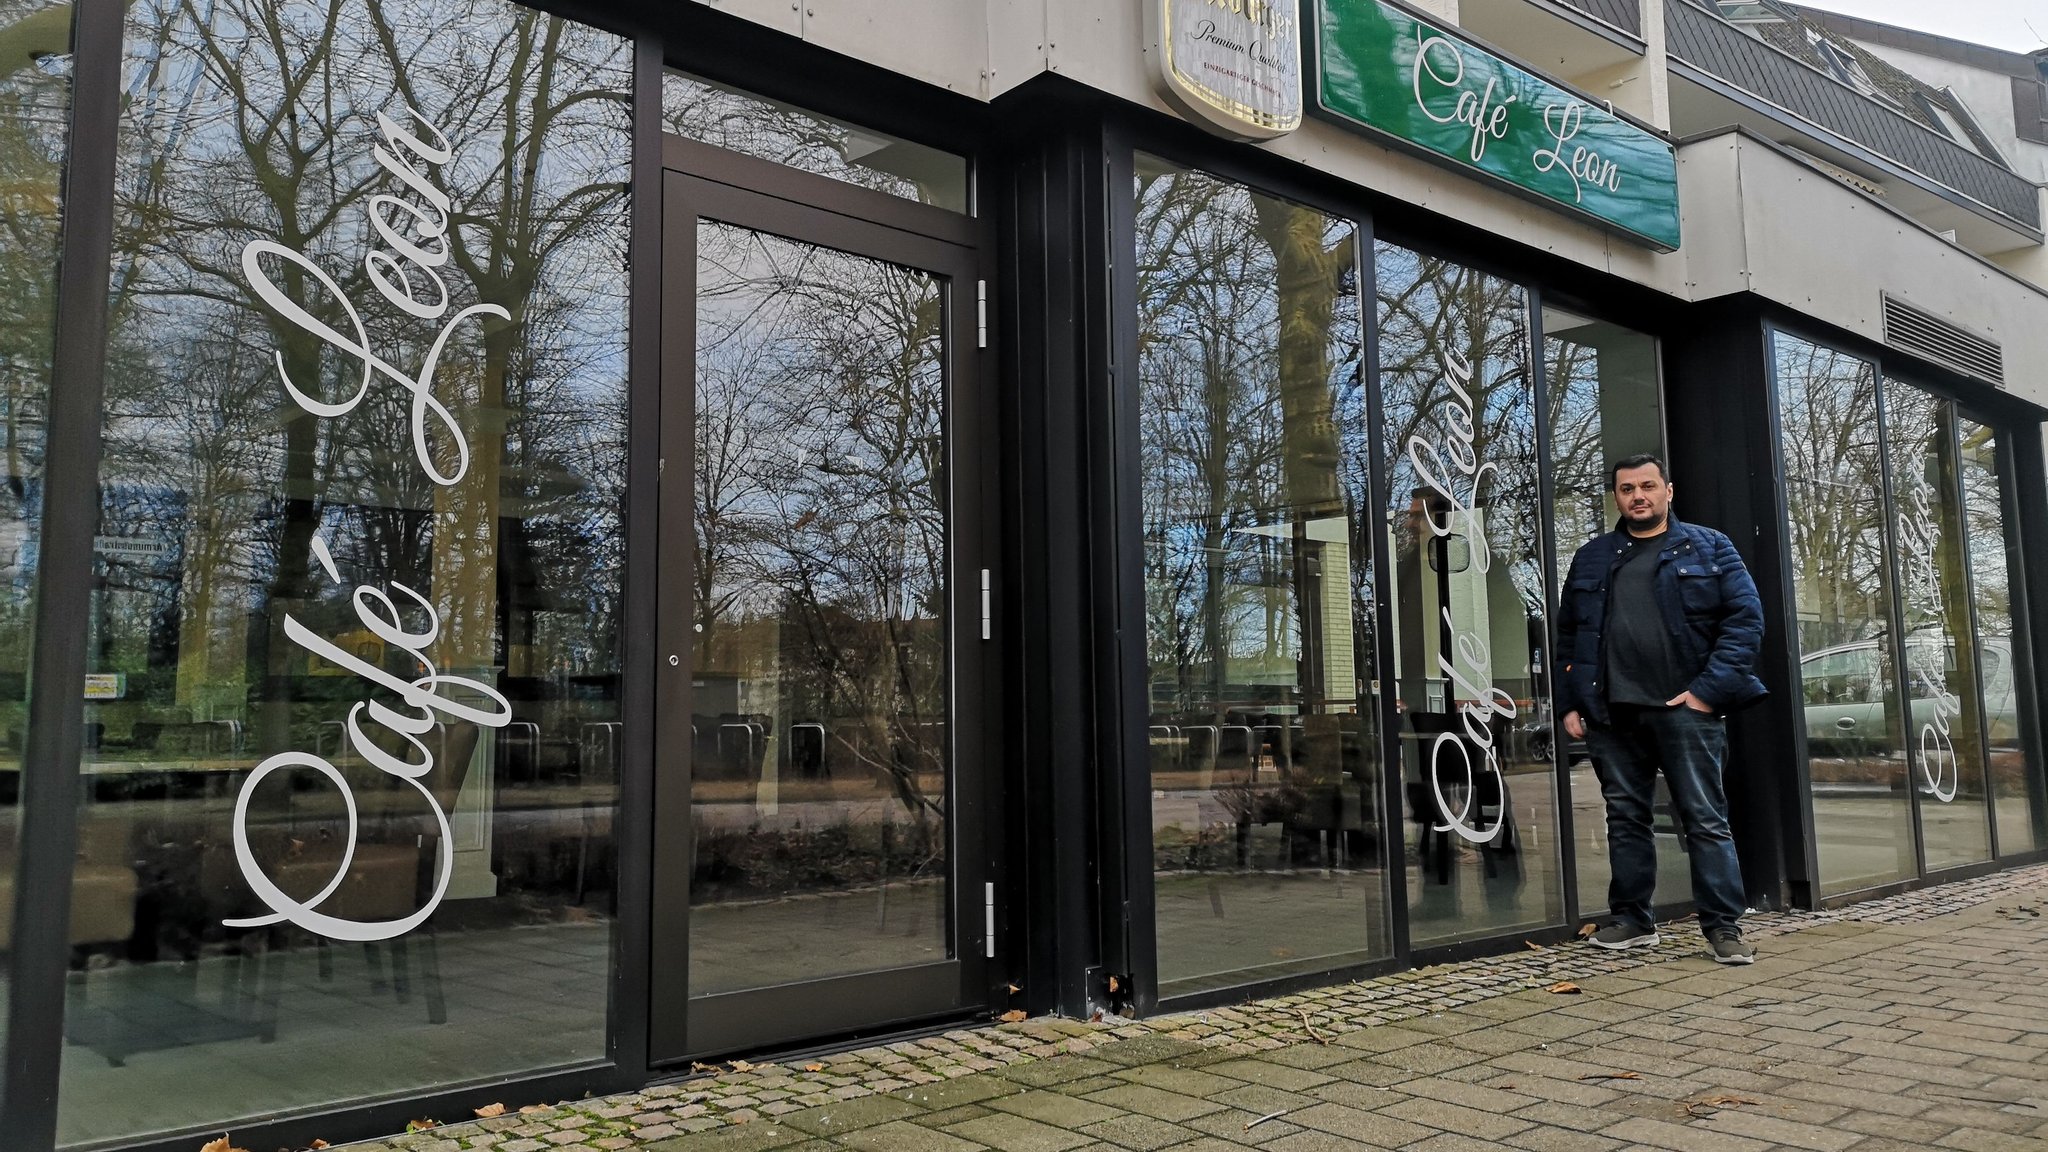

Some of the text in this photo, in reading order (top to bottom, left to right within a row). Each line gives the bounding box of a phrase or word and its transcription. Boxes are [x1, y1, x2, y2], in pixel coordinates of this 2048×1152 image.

[1190, 19, 1246, 54] Premium
[1413, 25, 1621, 204] Café Leon
[222, 105, 512, 942] Café Leon
[1408, 345, 1517, 844] Café Leon
